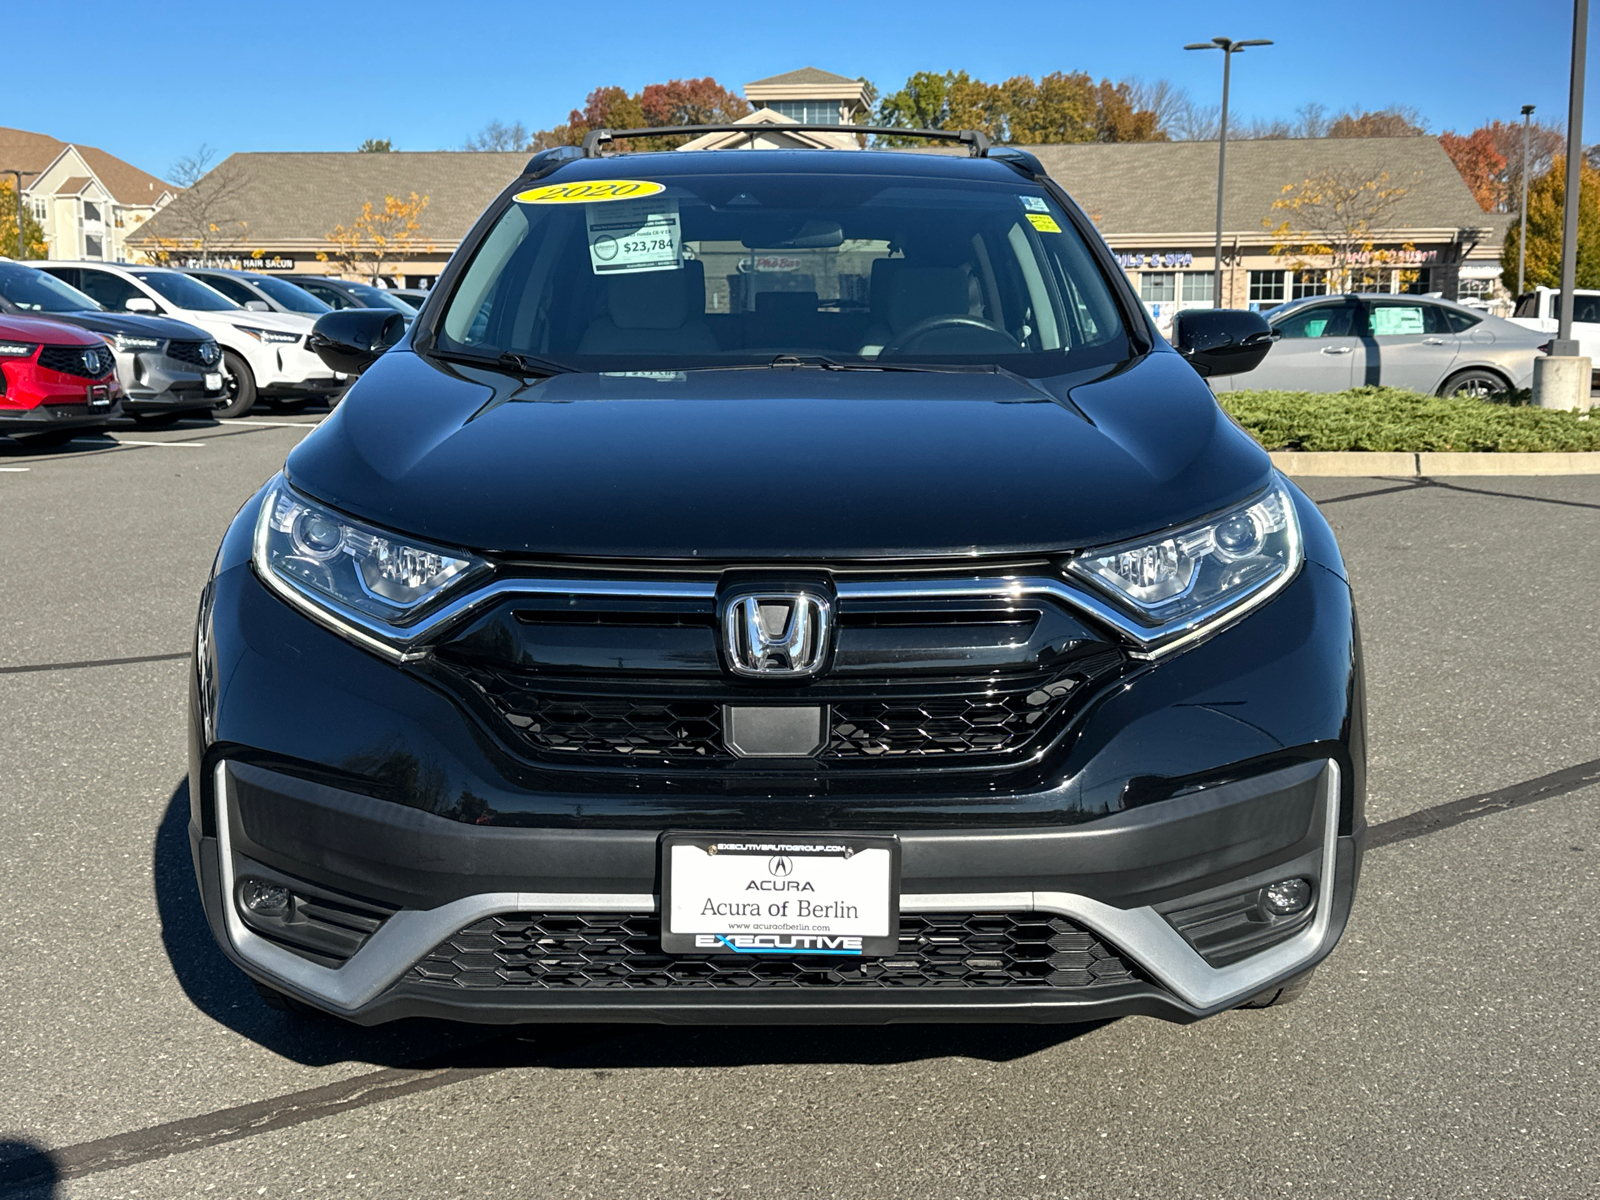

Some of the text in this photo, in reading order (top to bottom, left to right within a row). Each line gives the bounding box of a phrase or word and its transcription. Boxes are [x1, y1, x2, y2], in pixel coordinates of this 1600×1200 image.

[535, 184, 640, 200] 2020
[623, 238, 674, 254] $23,784
[243, 258, 264, 268] HAIR
[265, 258, 293, 269] SALON
[779, 256, 801, 268] Bar
[1165, 253, 1193, 266] SPA
[717, 843, 846, 852] EXECUTIVEAUTOGROUP.COM
[745, 880, 815, 892] ACURA
[700, 898, 859, 919] Acura of Berlin
[695, 934, 863, 950] EXECUTIVE
